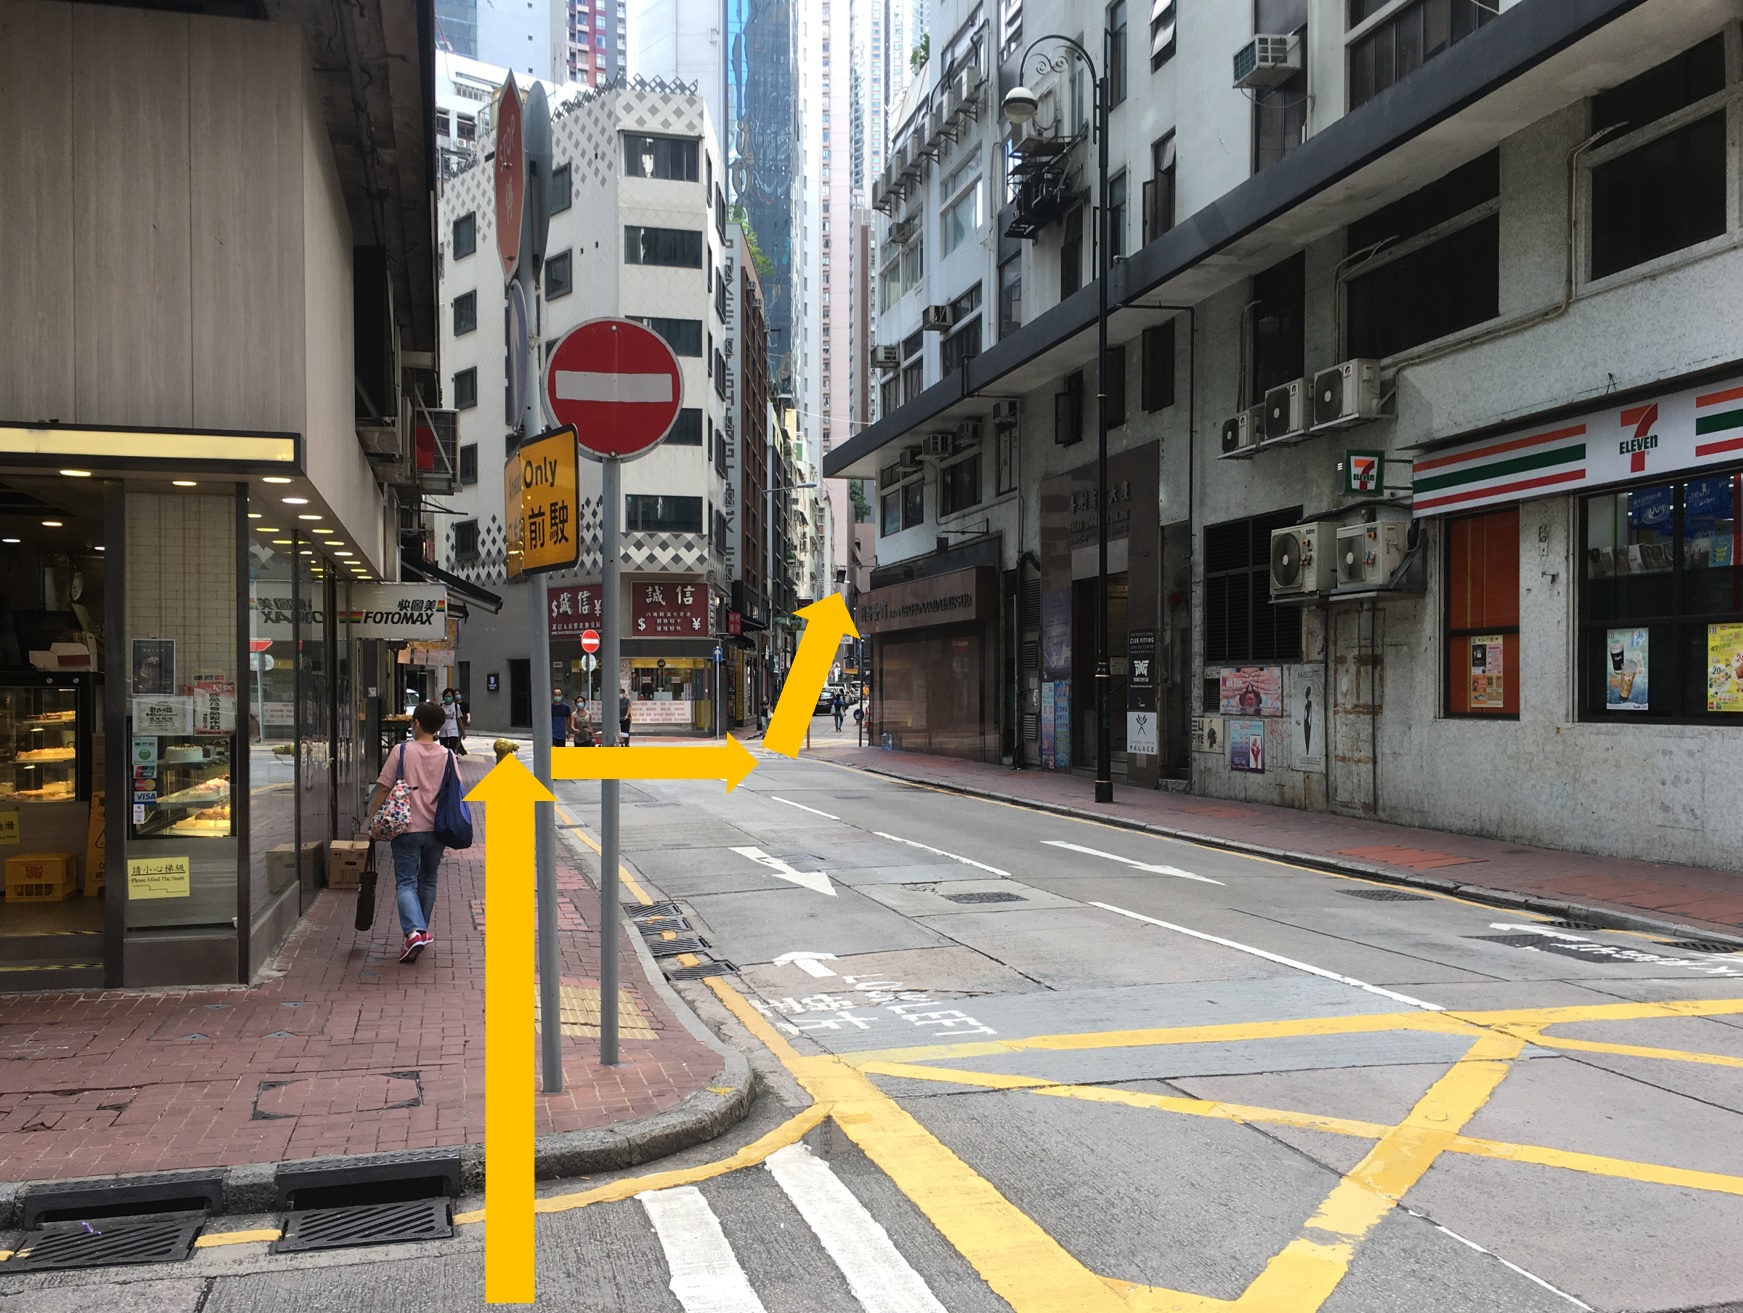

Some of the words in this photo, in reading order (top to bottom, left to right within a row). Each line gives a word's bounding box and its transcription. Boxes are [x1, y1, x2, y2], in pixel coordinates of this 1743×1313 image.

[500, 114, 515, 173] STOP
[1621, 403, 1658, 473] 7
[523, 456, 557, 488] Only
[1354, 459, 1375, 490] 7
[398, 599, 436, 612] 快圖美
[645, 585, 695, 606] 誠信
[363, 611, 435, 625] FOTOMAX
[1130, 745, 1154, 753] PALACE
[131, 863, 186, 876] 請小心梯級
[886, 1001, 998, 1036] LEFT
